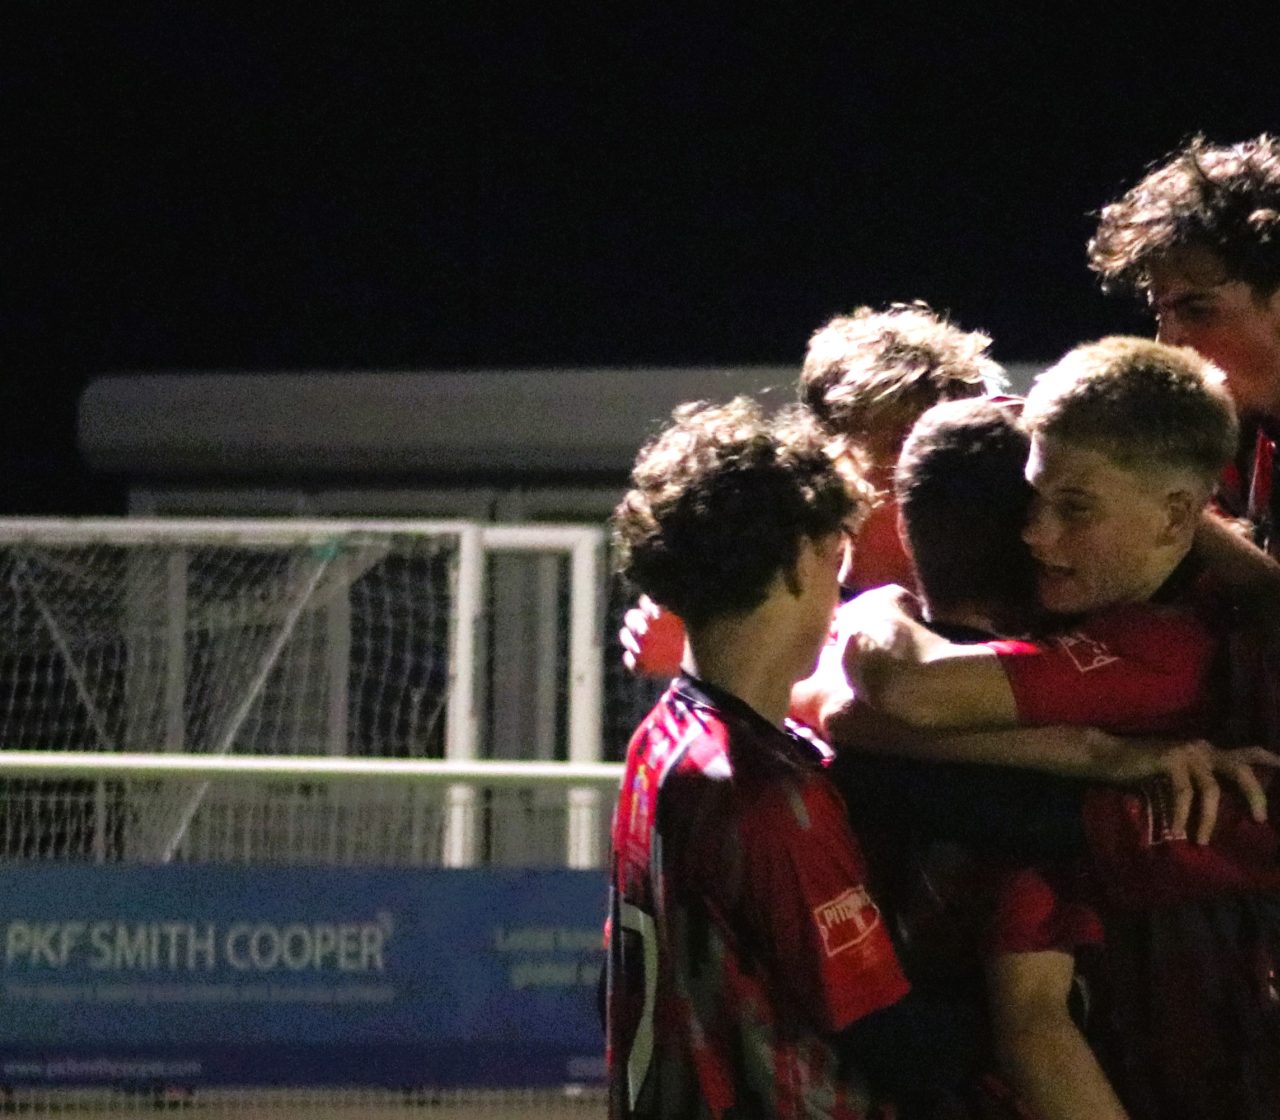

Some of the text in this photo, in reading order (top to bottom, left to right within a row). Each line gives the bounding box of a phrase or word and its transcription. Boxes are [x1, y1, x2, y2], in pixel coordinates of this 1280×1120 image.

[6, 920, 385, 971] PKF SMITH COOPER
